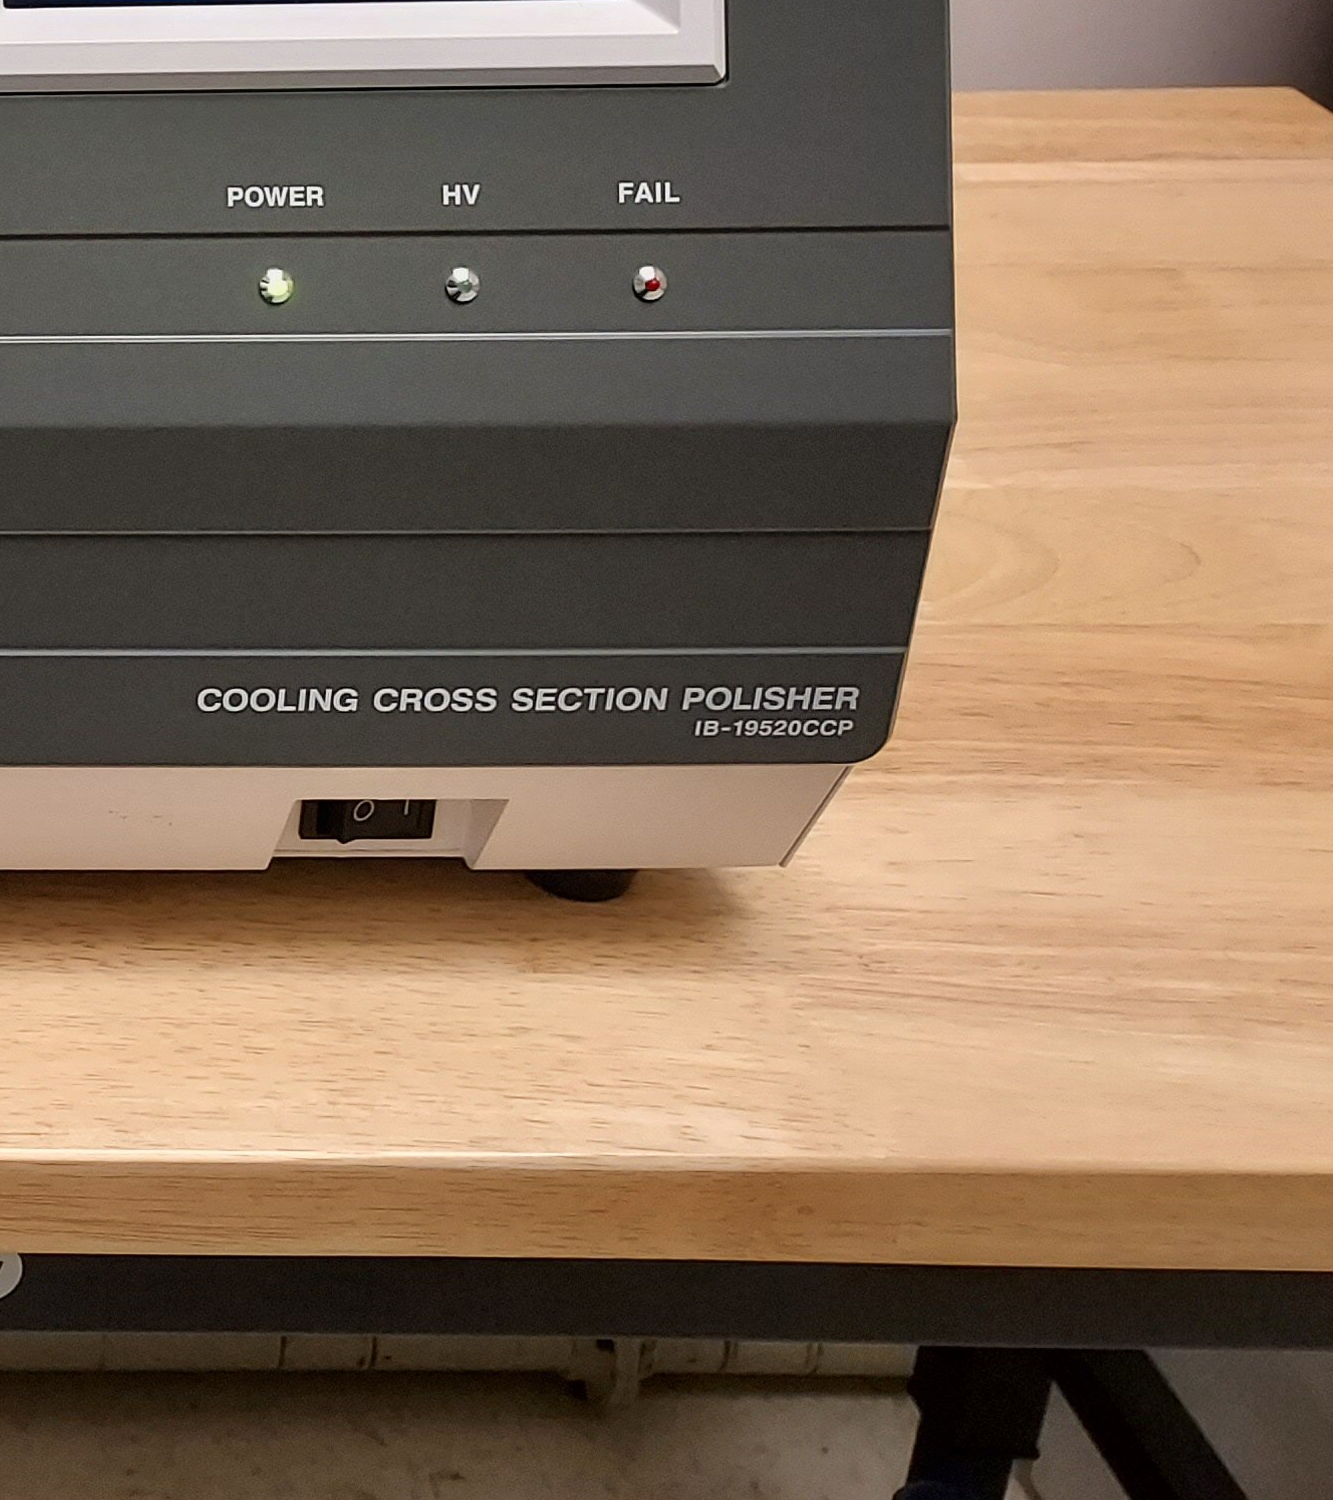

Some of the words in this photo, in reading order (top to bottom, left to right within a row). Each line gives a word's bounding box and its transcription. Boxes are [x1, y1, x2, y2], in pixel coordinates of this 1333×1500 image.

[227, 186, 325, 207] POWER
[441, 184, 480, 206] HV
[617, 182, 680, 204] FAIL
[197, 687, 359, 714] COOLING
[373, 687, 498, 713] CROSS
[511, 686, 669, 713] SECTION
[681, 686, 859, 712] POLISHER
[694, 719, 854, 738] IB-19520CCP
